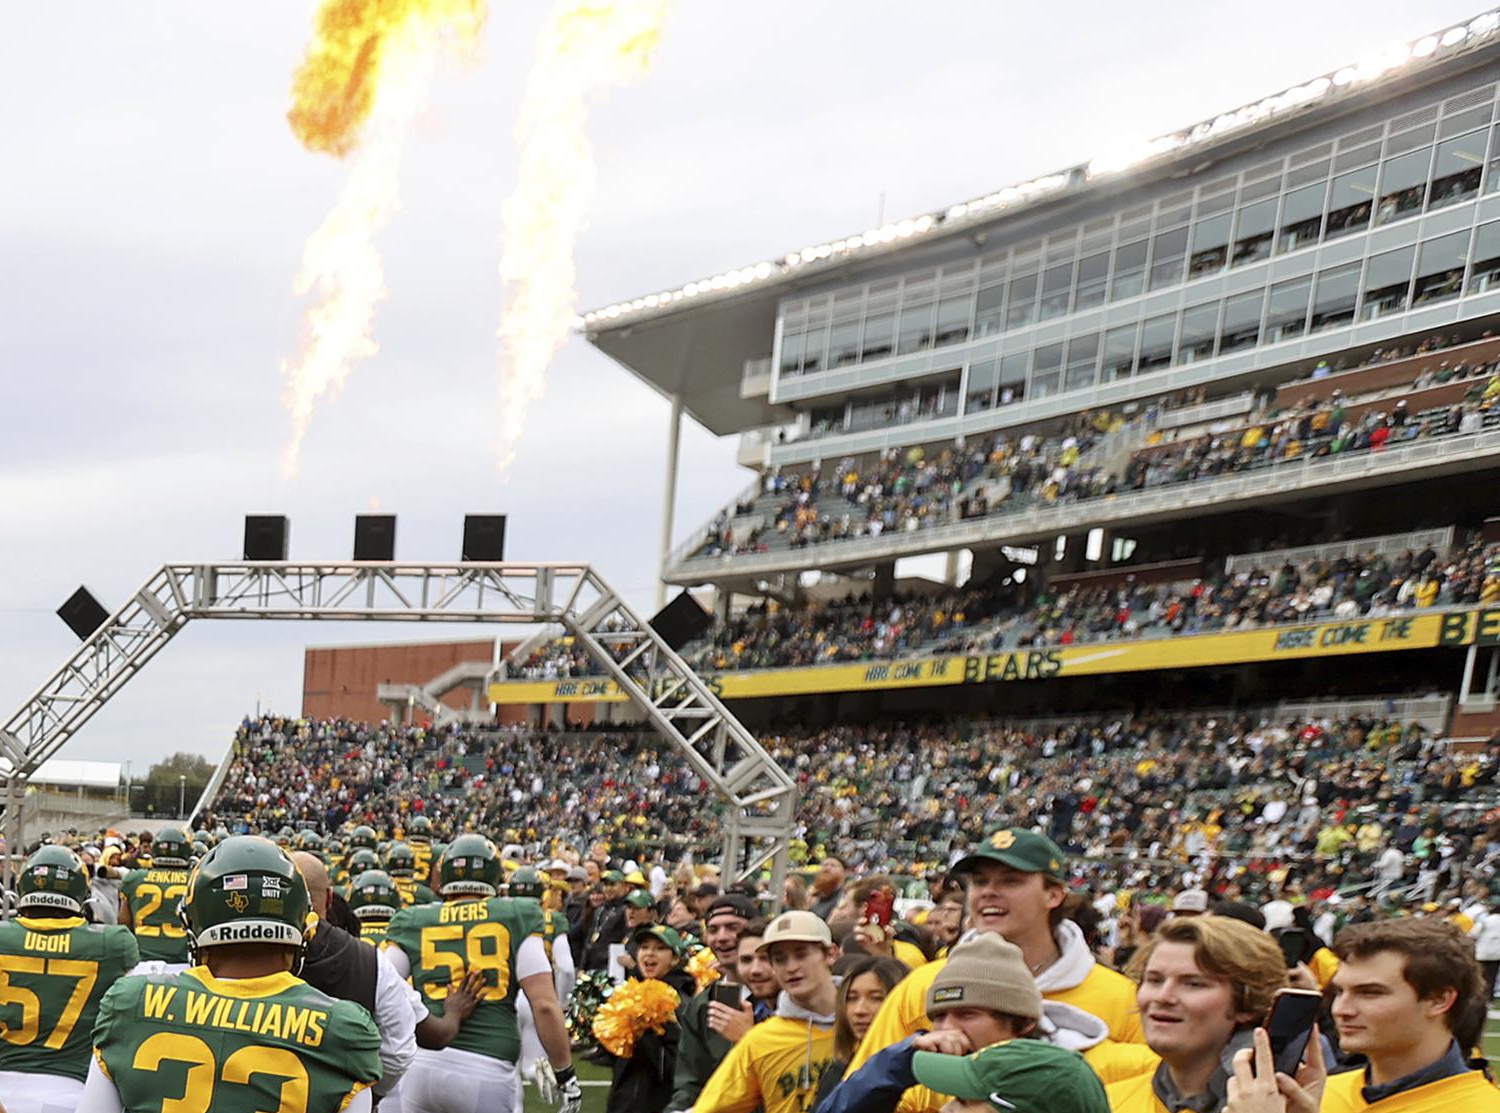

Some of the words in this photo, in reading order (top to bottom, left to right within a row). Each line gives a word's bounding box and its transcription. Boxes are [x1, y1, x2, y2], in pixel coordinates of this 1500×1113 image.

[1319, 624, 1370, 647] COME
[964, 650, 1062, 683] BEARS
[143, 870, 188, 884] JENKINS
[28, 894, 68, 907] Riddell
[261, 888, 280, 899] UNITY
[134, 883, 188, 938] 23
[440, 901, 488, 923] BYERS
[24, 931, 71, 953] UGOH
[220, 925, 285, 940] Riddell
[421, 921, 511, 1001] 58
[143, 984, 177, 1021] W.
[185, 991, 328, 1048] WILLIAMS
